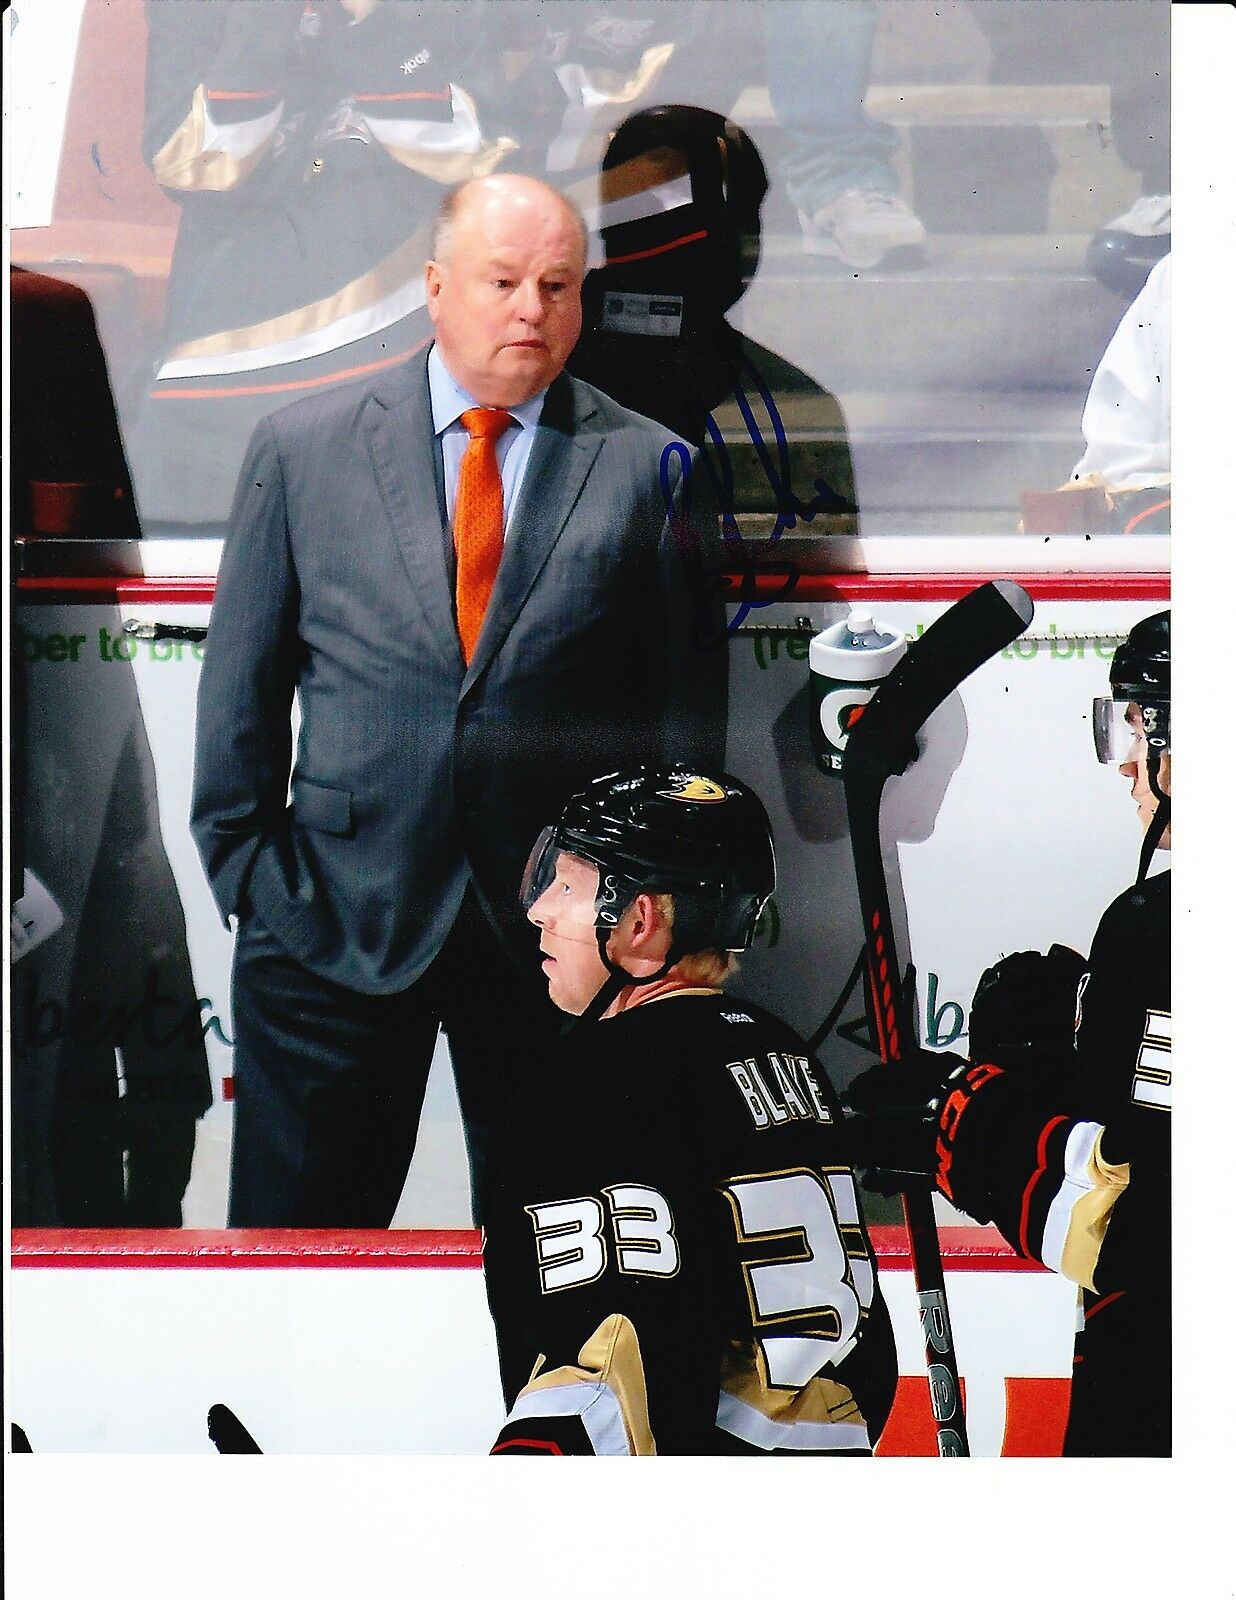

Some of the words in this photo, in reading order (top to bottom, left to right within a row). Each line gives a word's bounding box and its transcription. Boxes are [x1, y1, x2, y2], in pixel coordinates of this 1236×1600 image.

[100, 627, 137, 662] to
[726, 1052, 833, 1130] BLAKE
[523, 1183, 681, 1295] 33
